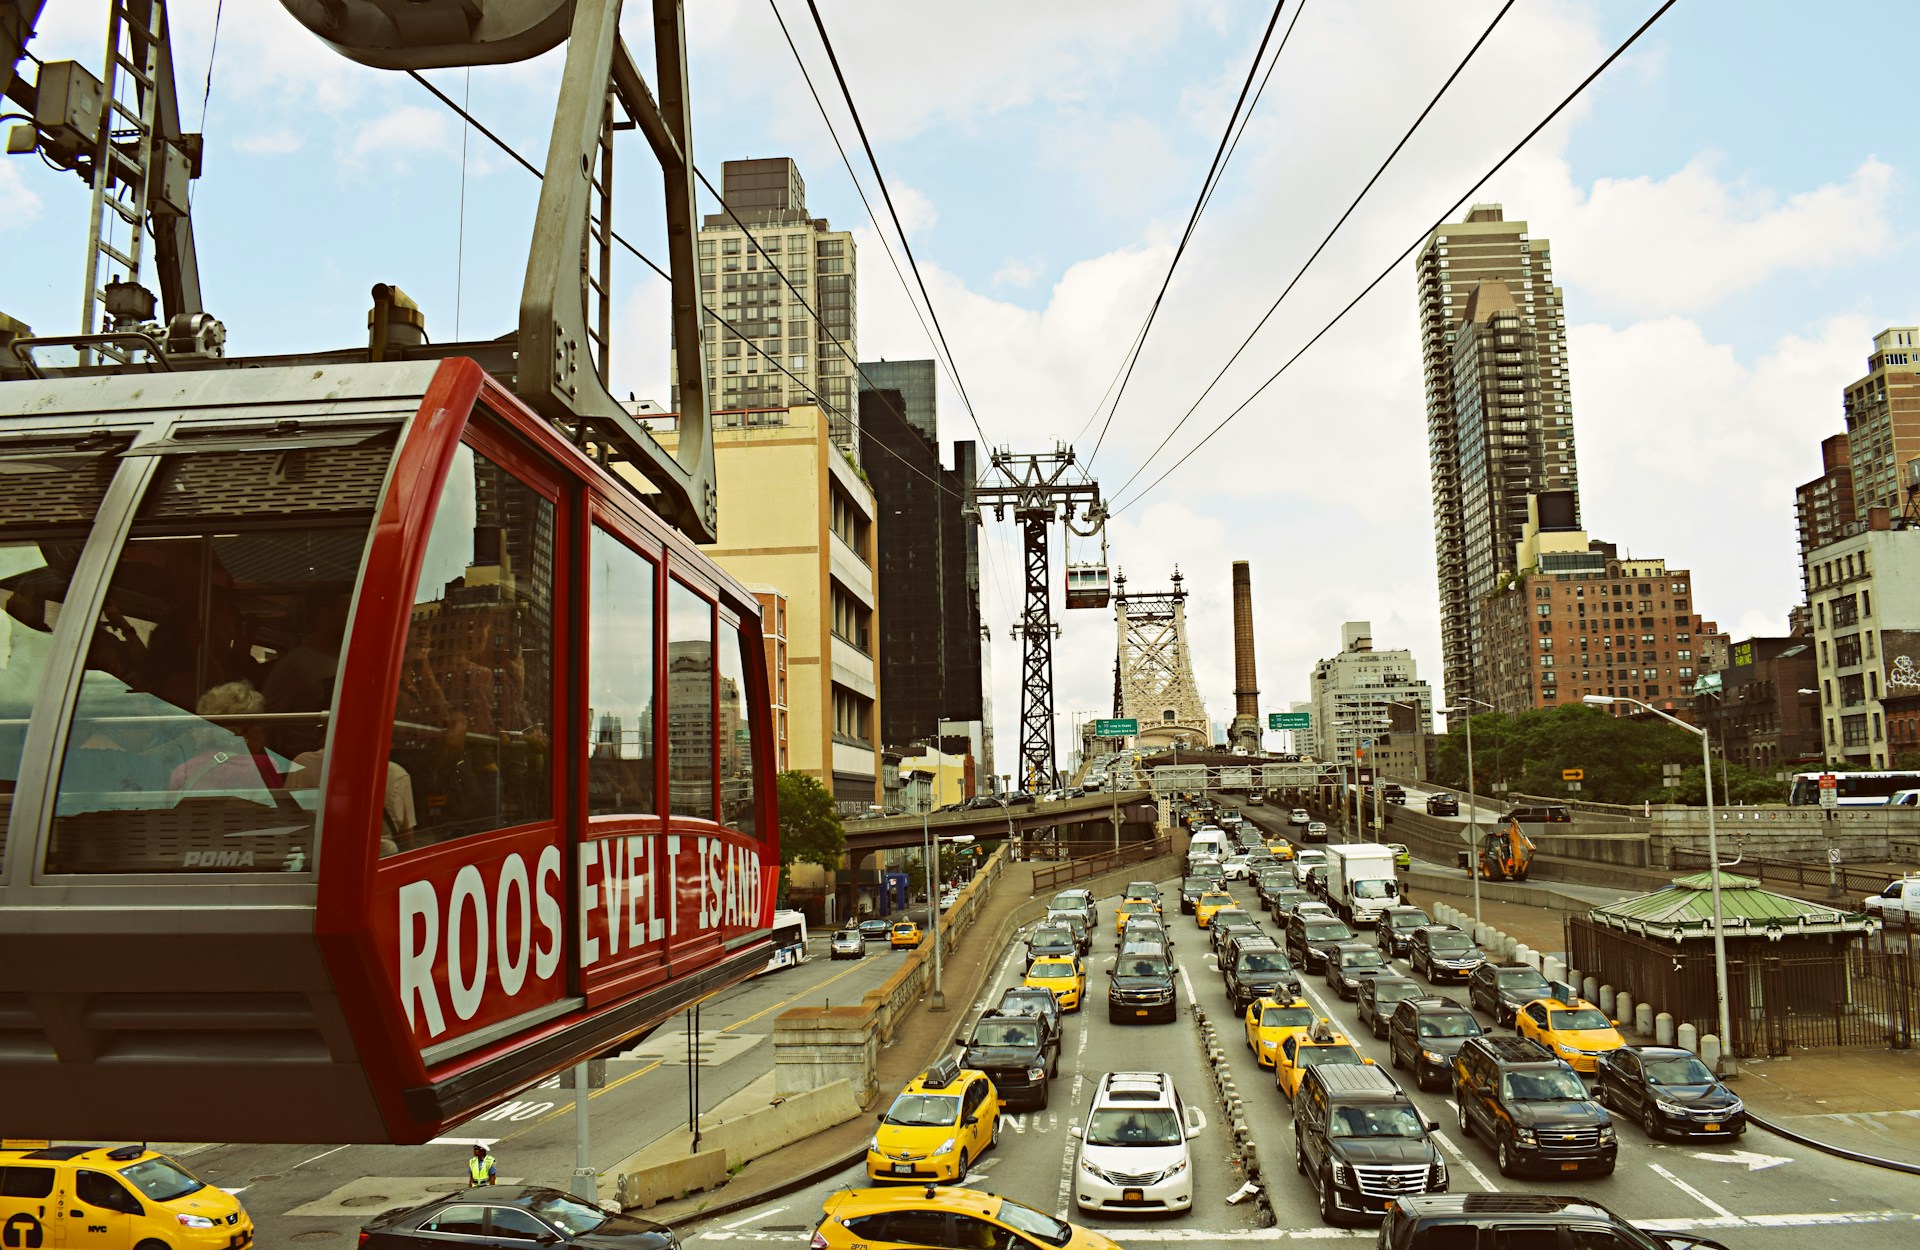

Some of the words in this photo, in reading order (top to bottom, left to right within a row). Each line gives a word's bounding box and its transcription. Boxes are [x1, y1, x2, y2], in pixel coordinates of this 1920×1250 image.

[182, 851, 255, 867] POMA
[400, 835, 680, 1038] ROOSEVELT
[87, 1225, 107, 1233] NYC
